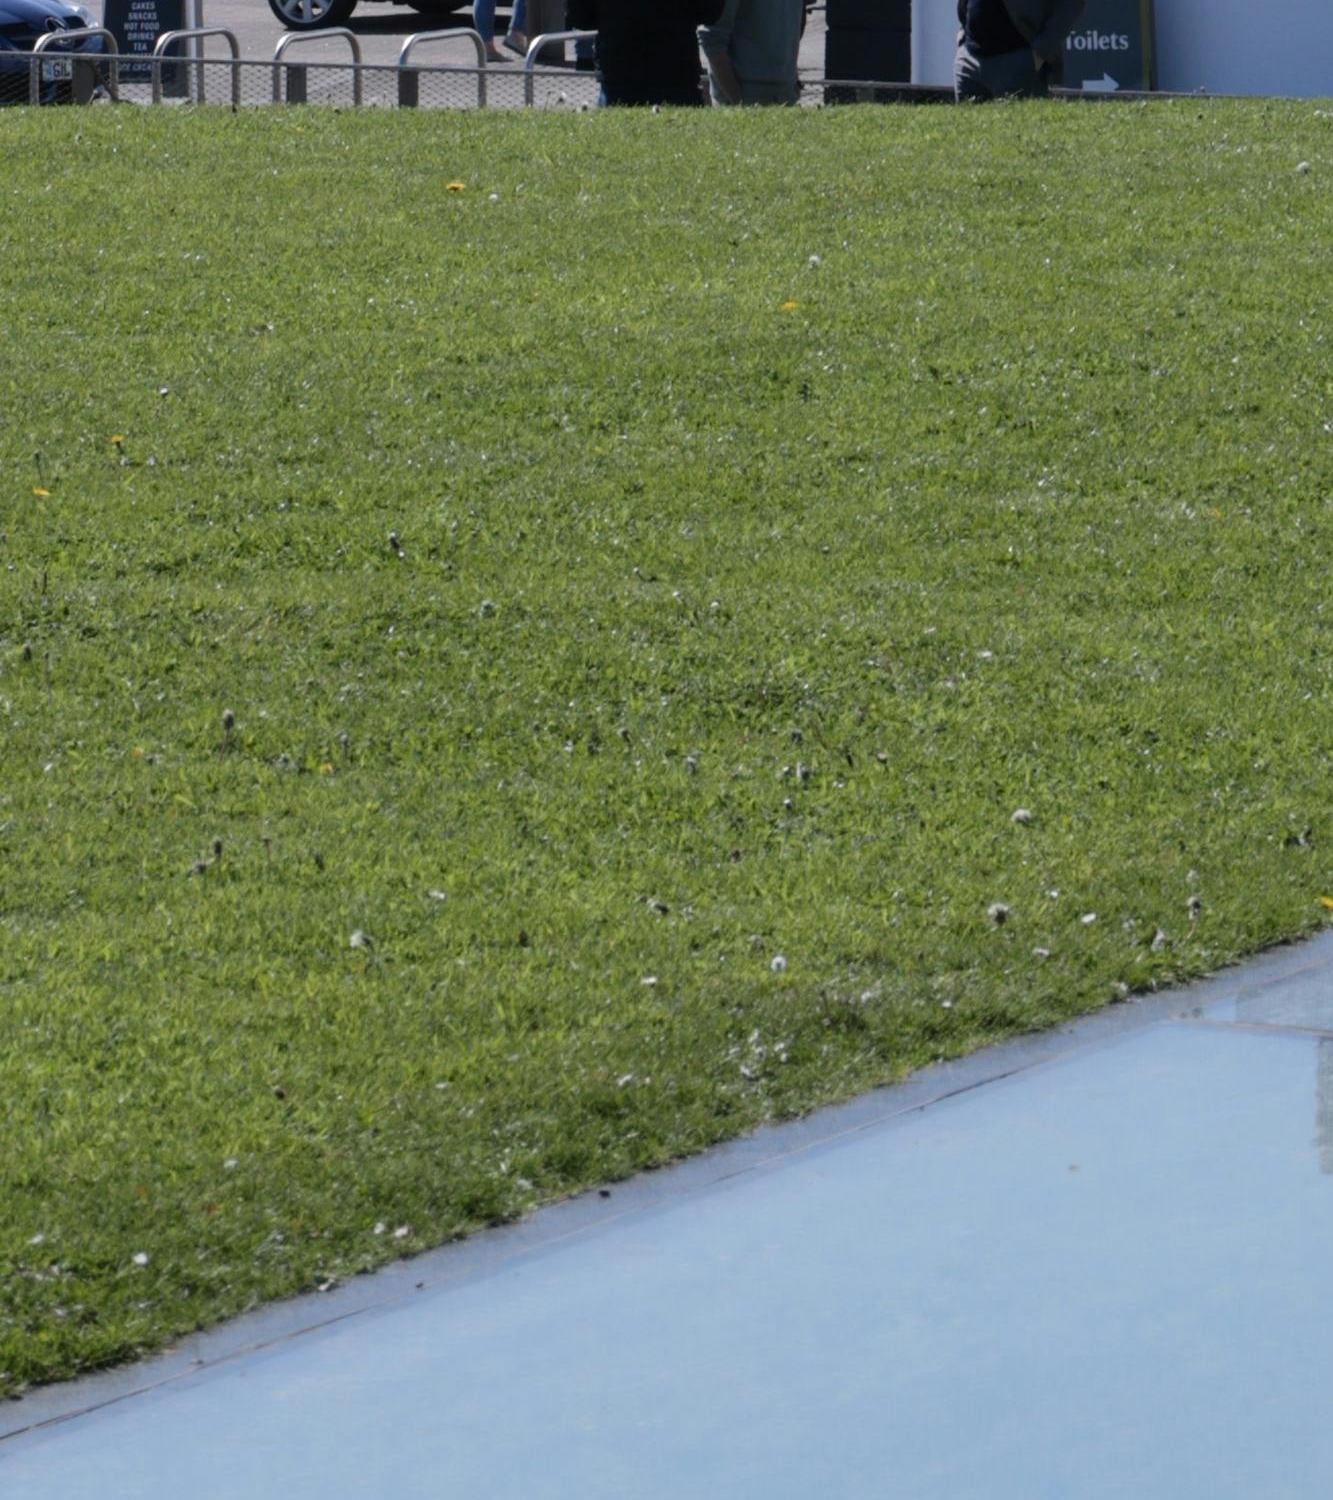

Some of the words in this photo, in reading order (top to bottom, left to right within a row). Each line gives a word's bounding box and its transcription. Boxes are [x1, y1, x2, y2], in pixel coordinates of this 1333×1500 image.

[131, 2, 156, 10] CAKES
[127, 12, 158, 20] SNACKS
[123, 22, 139, 30] HOT
[140, 22, 160, 30] FOOD
[127, 32, 155, 41] DRINKS
[133, 42, 148, 51] TEA
